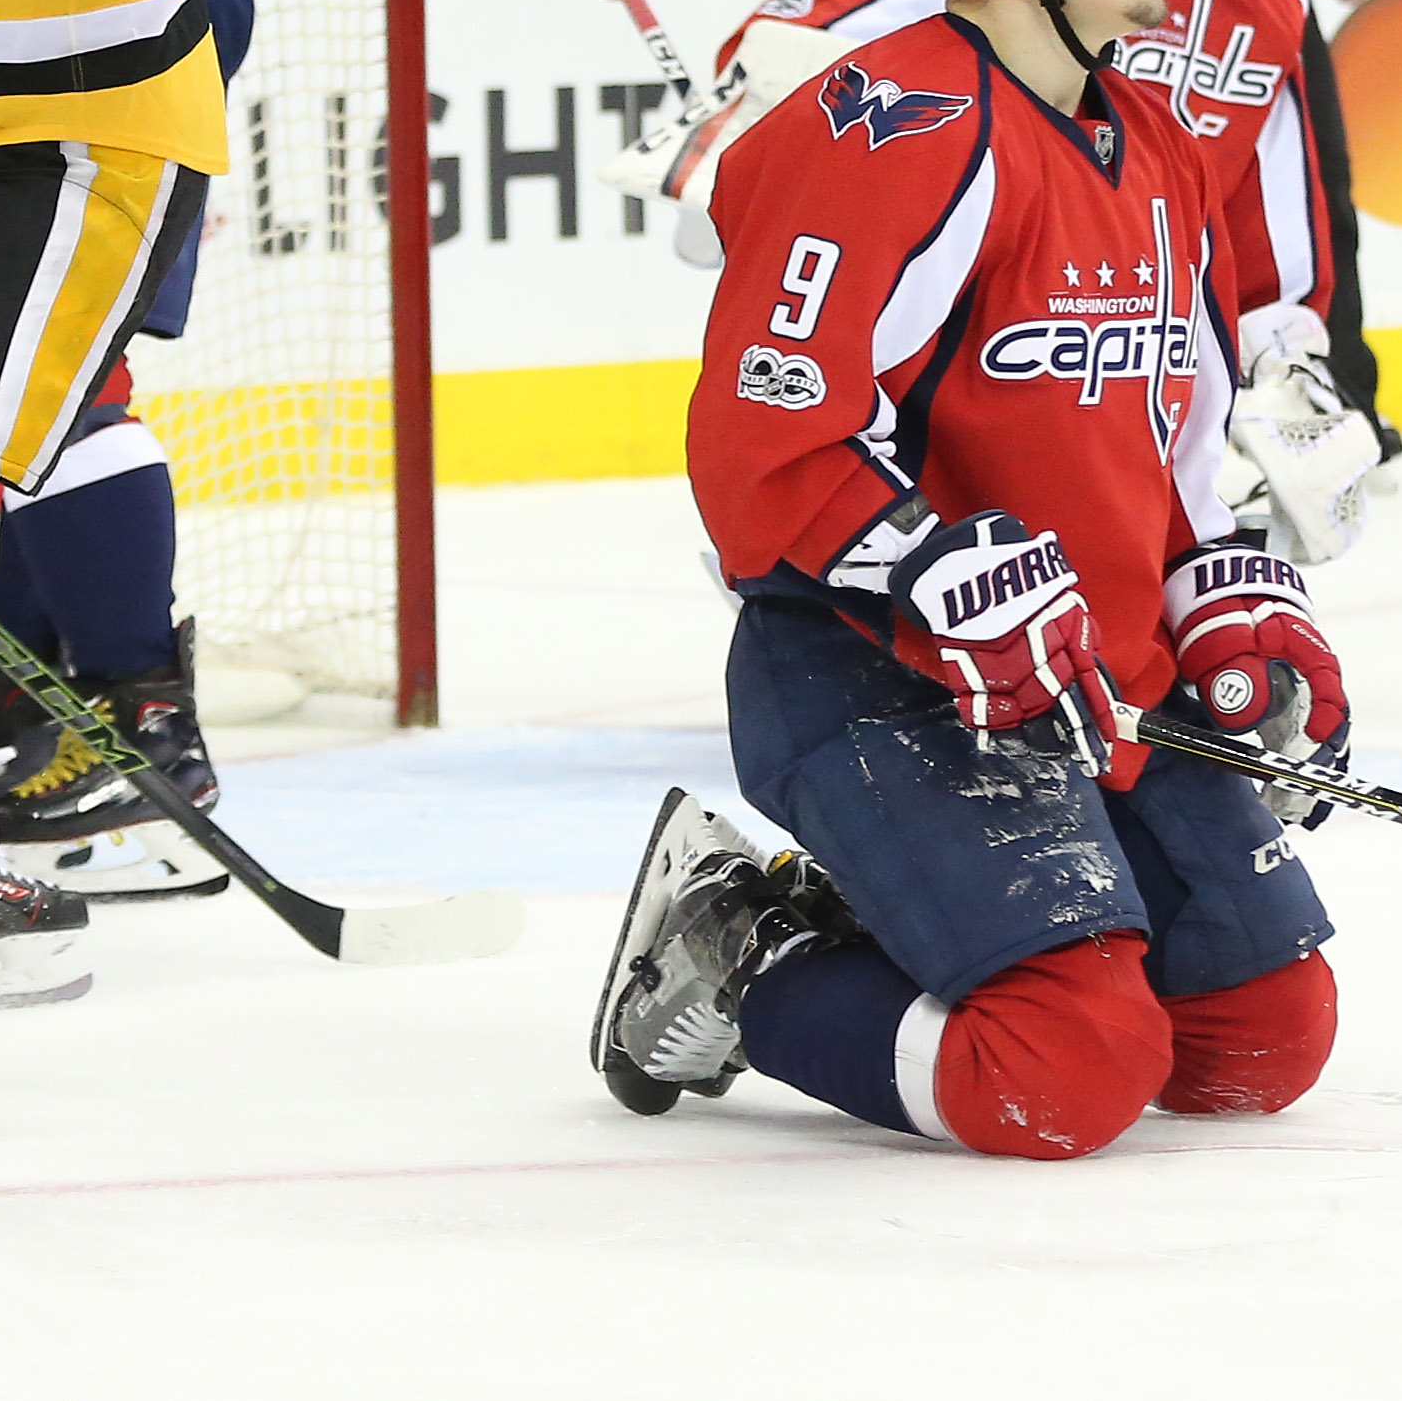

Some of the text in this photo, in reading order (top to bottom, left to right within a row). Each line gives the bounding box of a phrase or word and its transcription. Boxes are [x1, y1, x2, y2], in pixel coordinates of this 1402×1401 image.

[249, 83, 667, 255] LIGHT
[768, 234, 842, 341] 9
[980, 197, 1199, 467] capital
[1047, 295, 1156, 314] WASHINGTON
[942, 539, 1073, 629] WARR
[1291, 623, 1332, 654] COVERT
[1259, 750, 1380, 795] CCM
